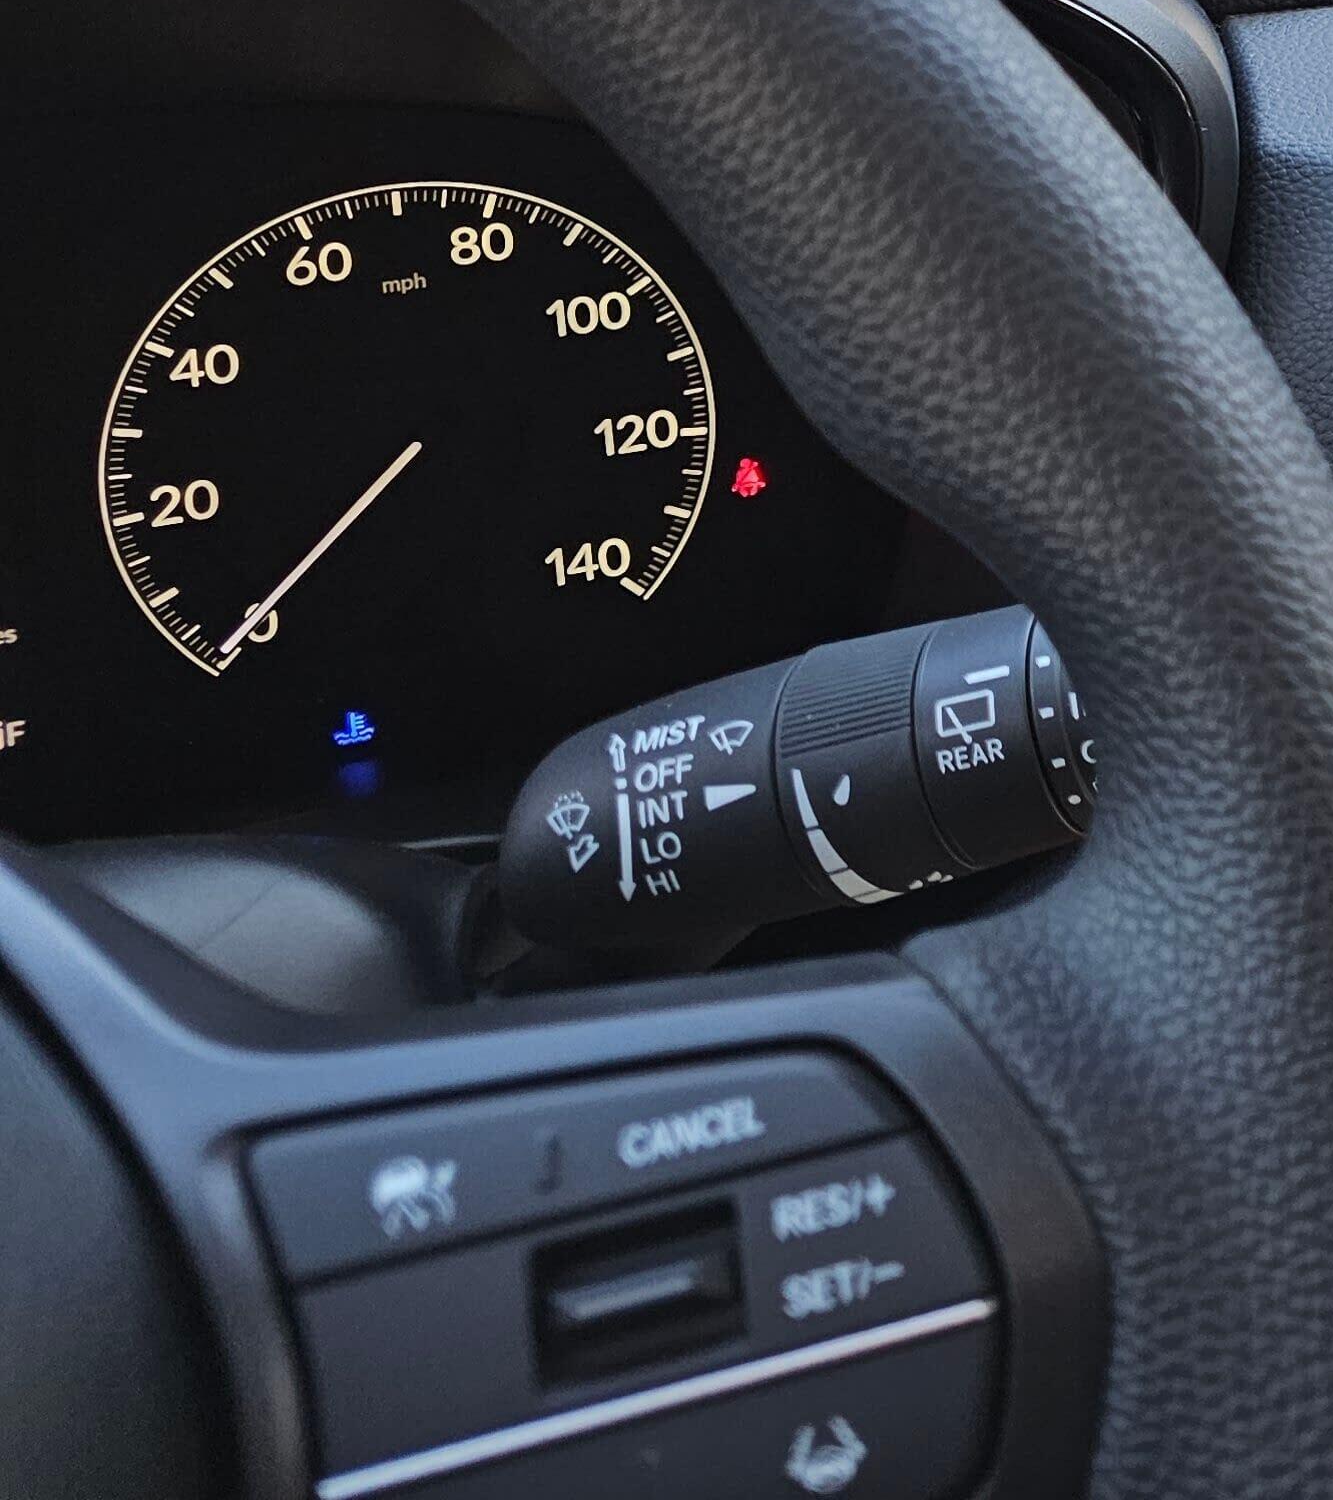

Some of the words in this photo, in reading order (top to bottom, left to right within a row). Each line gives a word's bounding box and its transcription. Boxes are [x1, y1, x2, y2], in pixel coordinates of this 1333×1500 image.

[285, 241, 353, 286] 60
[450, 222, 514, 266] 80
[381, 272, 428, 295] mph
[545, 291, 632, 338] 100
[168, 344, 240, 388] 40
[593, 409, 679, 457] 120
[149, 479, 220, 528] 20
[544, 537, 631, 587] 140
[632, 715, 706, 755] MIST
[935, 737, 1005, 775] REAR
[633, 753, 694, 793] OFF
[636, 789, 689, 829] INT
[639, 832, 682, 865] LO
[645, 868, 681, 896] HI
[618, 1097, 766, 1169] CANCEL
[771, 1174, 896, 1241] RES/+
